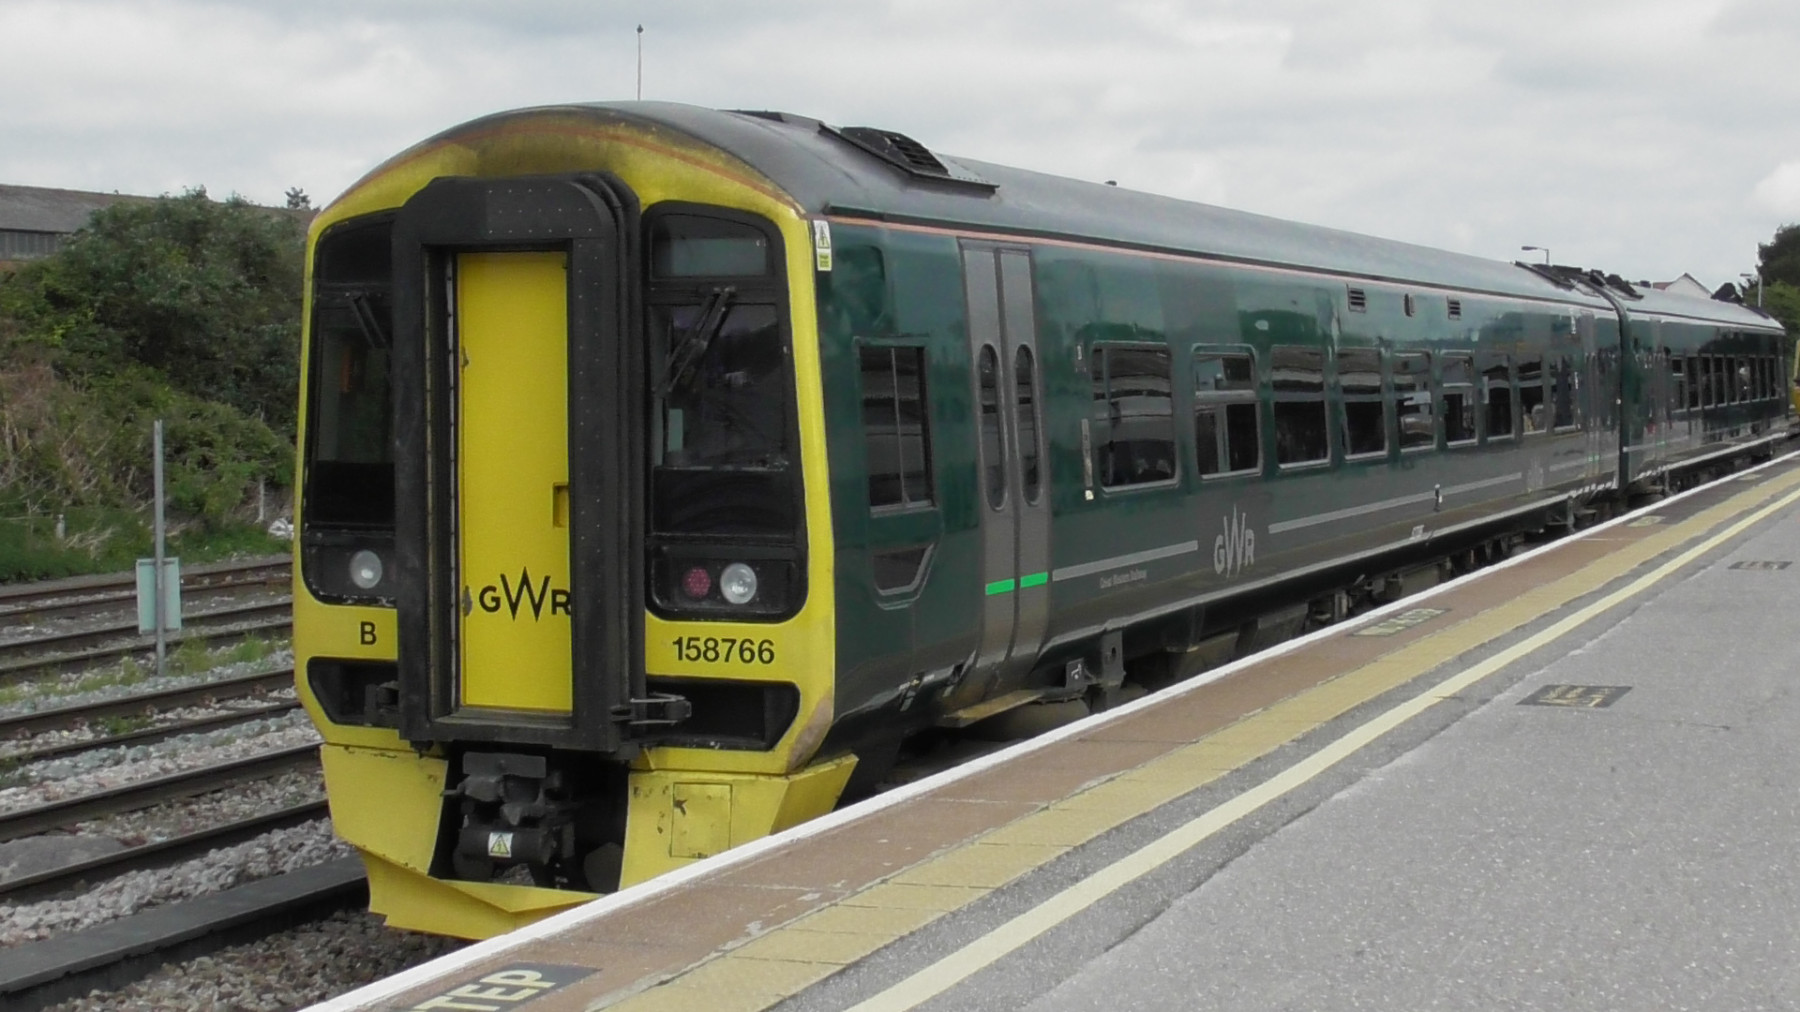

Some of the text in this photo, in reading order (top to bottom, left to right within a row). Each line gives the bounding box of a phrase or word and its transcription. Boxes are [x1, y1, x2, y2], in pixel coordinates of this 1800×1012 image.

[1214, 503, 1255, 579] GWR
[479, 567, 571, 622] GWR
[360, 621, 377, 646] B
[672, 637, 775, 664] 158766
[408, 969, 556, 1012] TEP
